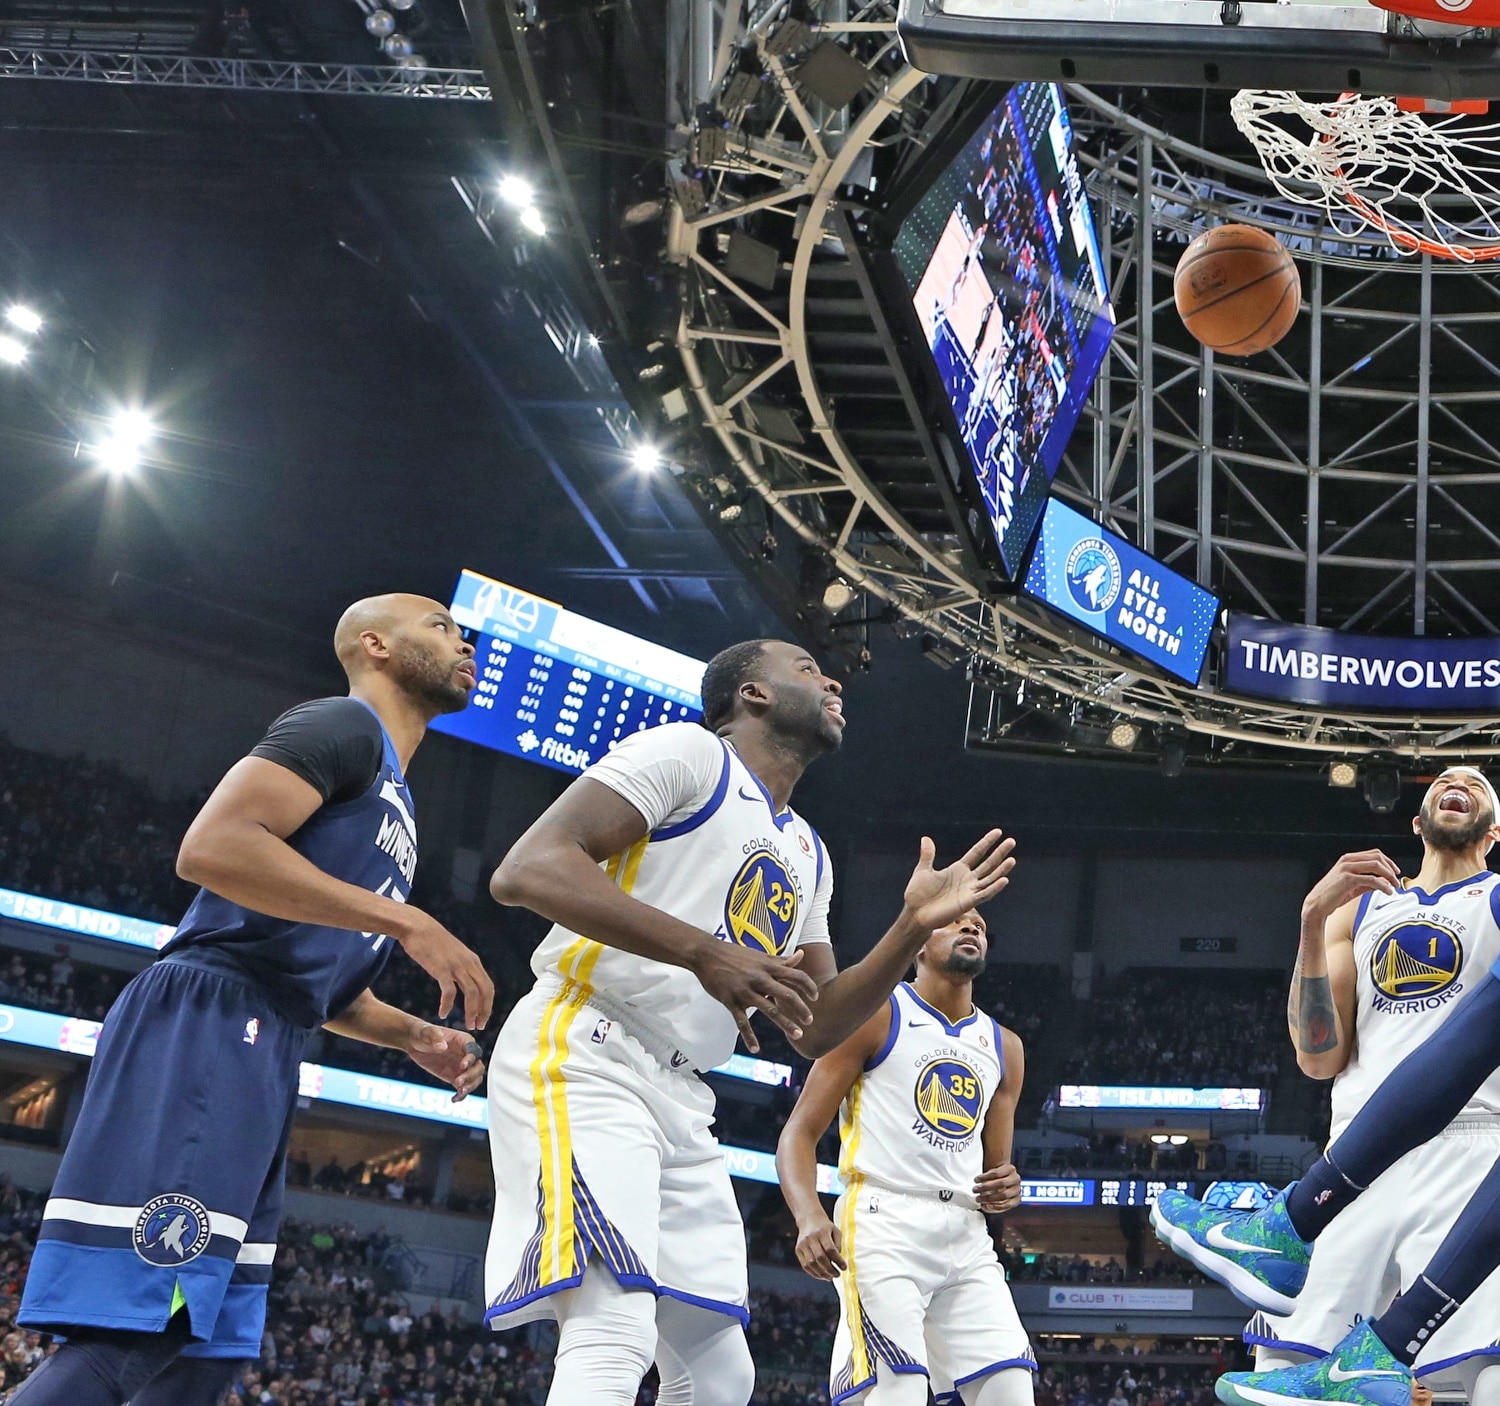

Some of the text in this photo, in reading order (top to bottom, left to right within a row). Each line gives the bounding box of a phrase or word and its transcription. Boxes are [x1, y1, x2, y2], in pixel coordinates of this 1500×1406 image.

[1128, 569, 1160, 600] ALL
[1123, 587, 1168, 625] EYES
[1118, 607, 1181, 656] NORTH
[742, 838, 804, 904] GOLDEN STATE
[767, 882, 795, 922] 23
[13, 896, 121, 936] ISLAND
[121, 928, 152, 945] TIME
[1431, 912, 1467, 935] STATE
[1196, 939, 1221, 951] 220
[1428, 937, 1438, 959] 1
[1371, 982, 1464, 1015] WARRIORS
[914, 1048, 987, 1082] GOLDEN STATE
[950, 1075, 977, 1100] 35
[1119, 1087, 1196, 1106] ISLAND
[1195, 1097, 1218, 1106] TIME
[1036, 1186, 1084, 1198] NORTH
[135, 1197, 209, 1254] MINNESOTA TIMBERWOLVES
[1069, 1293, 1105, 1303] CLUB
